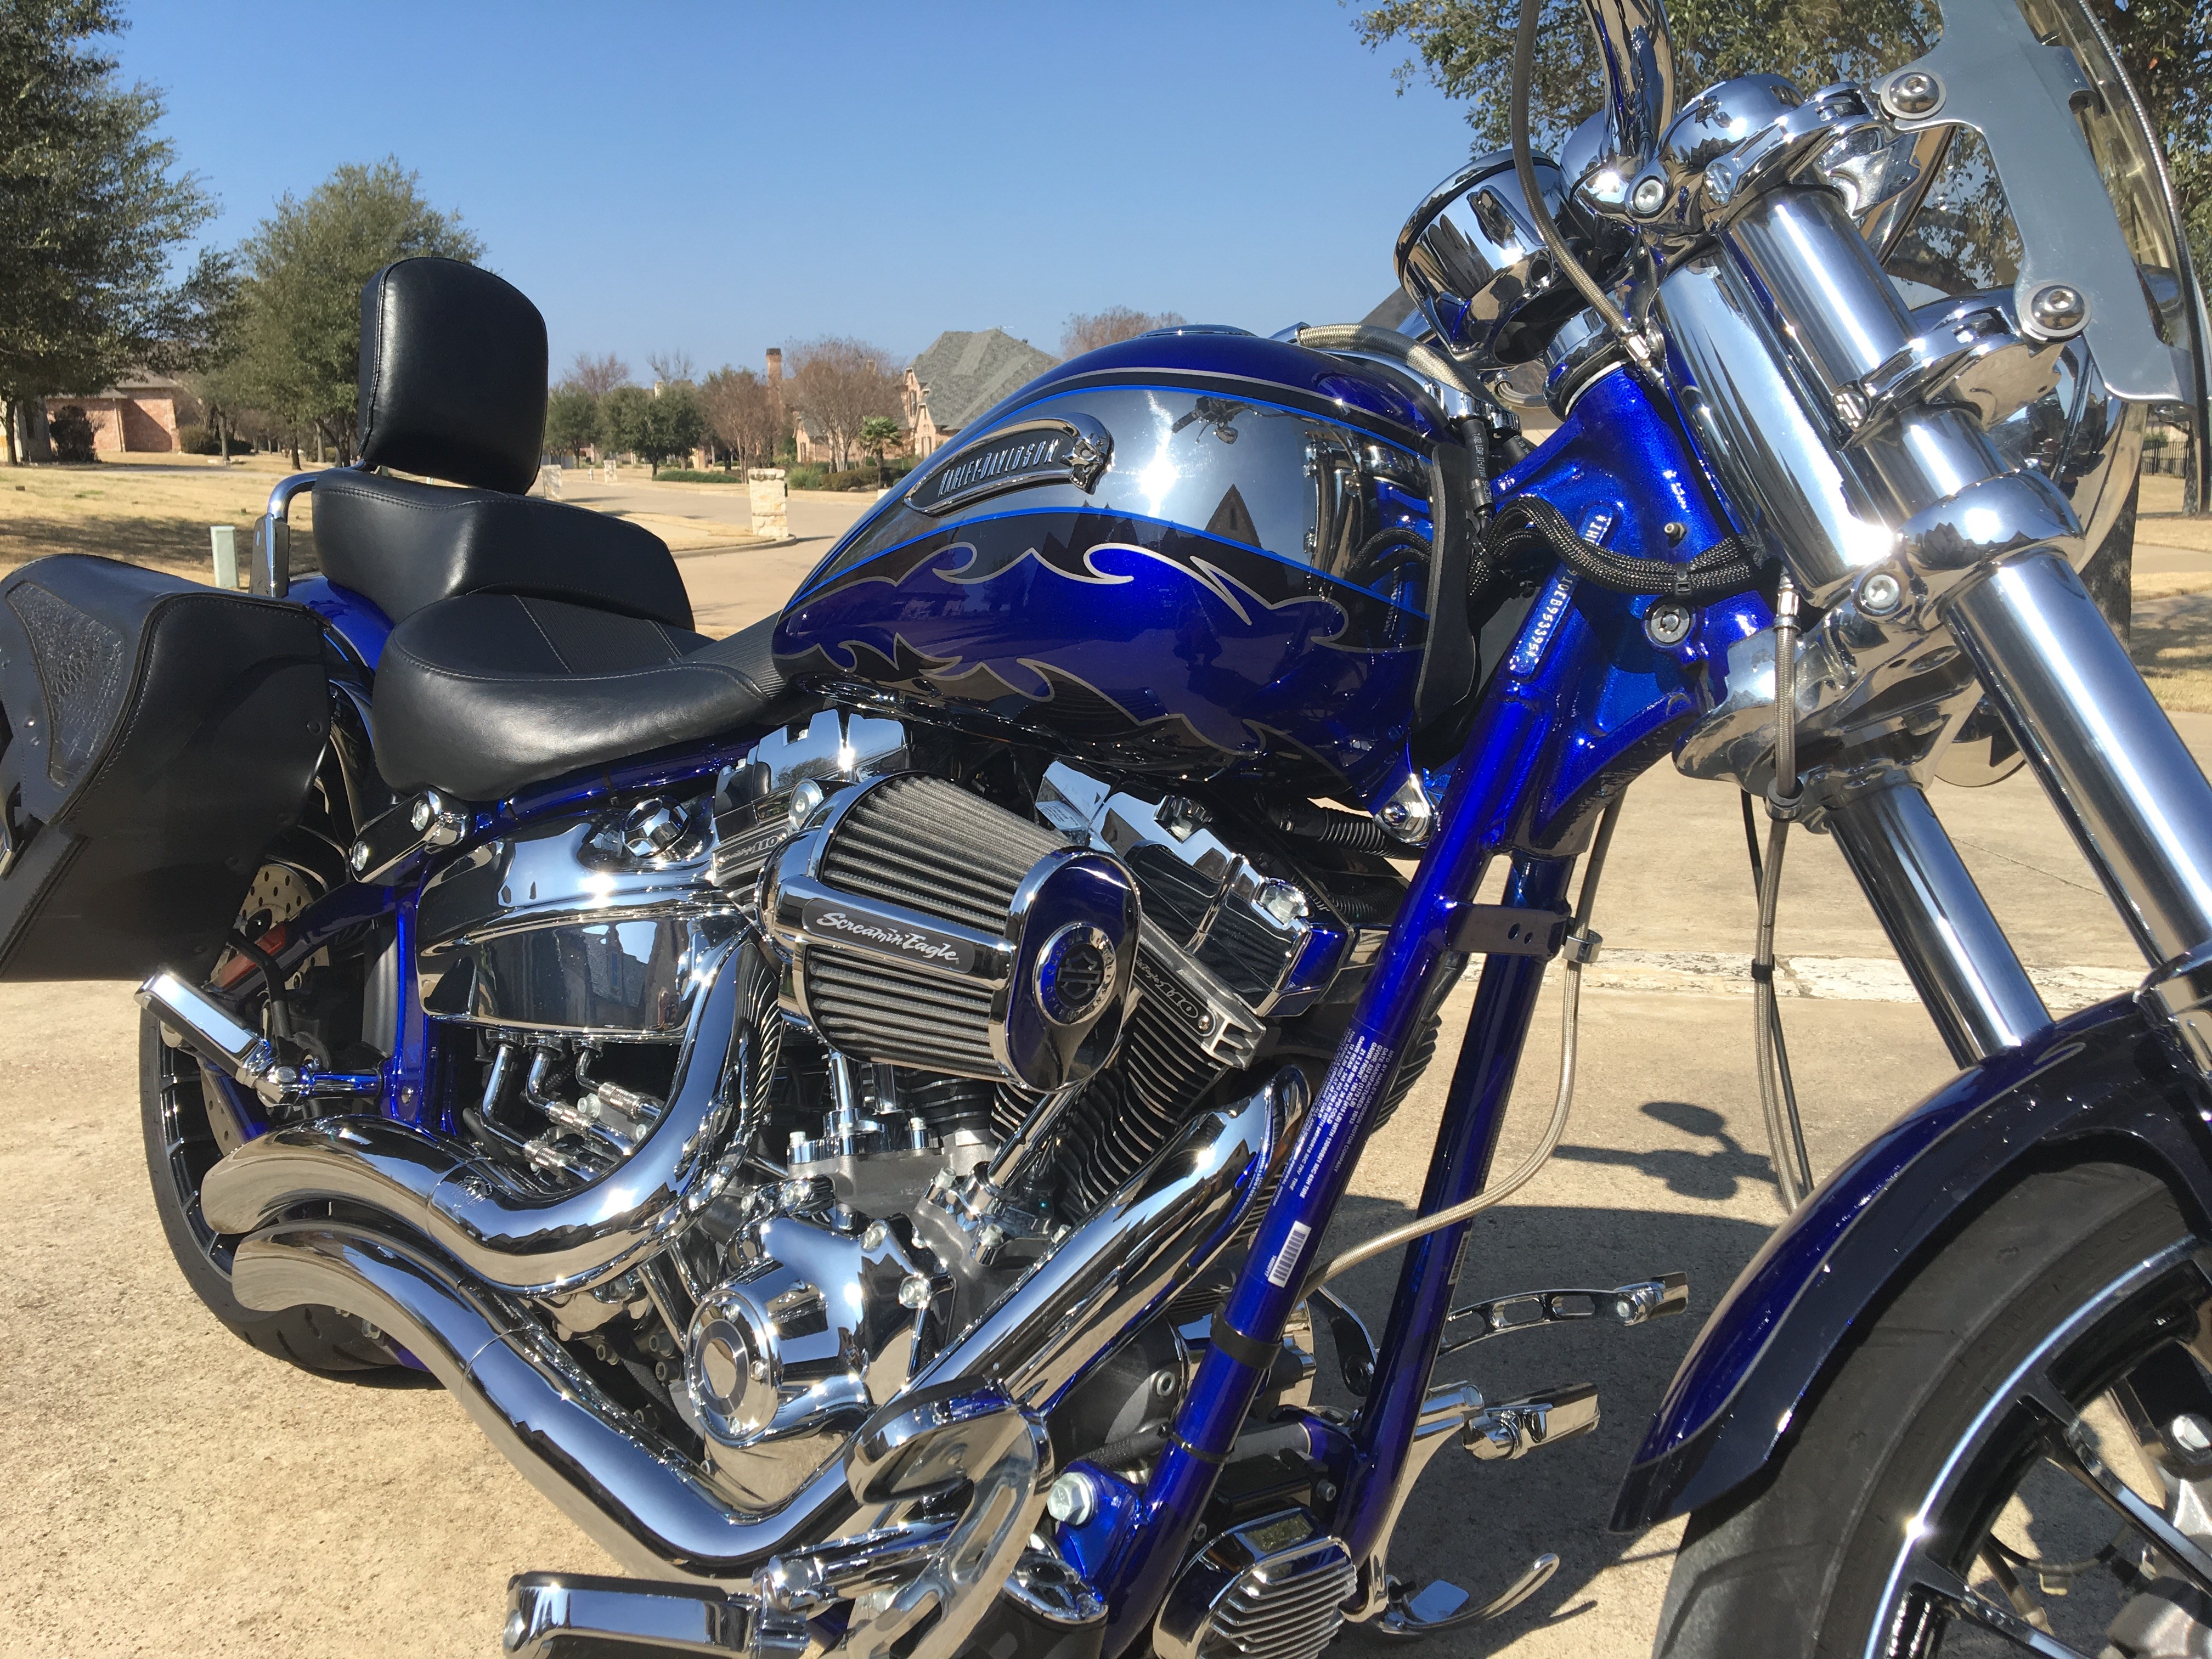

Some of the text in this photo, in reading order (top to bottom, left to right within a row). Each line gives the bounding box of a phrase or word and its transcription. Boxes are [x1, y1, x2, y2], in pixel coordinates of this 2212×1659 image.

[938, 438, 1063, 497] HARLEY-DAVIDSON
[748, 834, 781, 854] 110
[902, 933, 960, 960] Eagle
[1352, 1035, 1365, 1053] GAWR
[1364, 1041, 1378, 1060] GAWR
[1335, 1042, 1350, 1066] VEHICLE
[1345, 1052, 1357, 1069] REAR
[1369, 1043, 1383, 1064] GVWR:
[1377, 1047, 1389, 1063] DATE
[1335, 1066, 1344, 1077] RIM
[1351, 1059, 1361, 1073] 3.50
[1355, 1058, 1369, 1079] FRONT
[1365, 1063, 1374, 1074] 533
[1380, 1063, 1387, 1072] BY
[1332, 1076, 1339, 1085] AT
[1346, 1071, 1355, 1083] RIM
[1361, 1073, 1369, 1083] KG
[1335, 1081, 1343, 1091] KG
[1342, 1082, 1350, 1091] AT
[1317, 1098, 1324, 1107] TO
[1334, 1097, 1342, 1108] PSI
[1345, 1091, 1354, 1101] KG
[1348, 1096, 1358, 1108] LB)
[1355, 1071, 1384, 1124] HARLEY-DAVIDSON
[1316, 1101, 1328, 1119] COLD
[1339, 1099, 1350, 1113] (415
[1318, 1111, 1329, 1127] WITH
[1325, 1107, 1338, 1125] COLD
[1328, 1121, 1339, 1137] WITH
[1345, 1124, 1359, 1145] MOTOR
[1332, 1144, 1350, 1172] COMPANY
[1288, 1176, 1299, 1191] TIRE
[1298, 1184, 1310, 1199] TIRE
